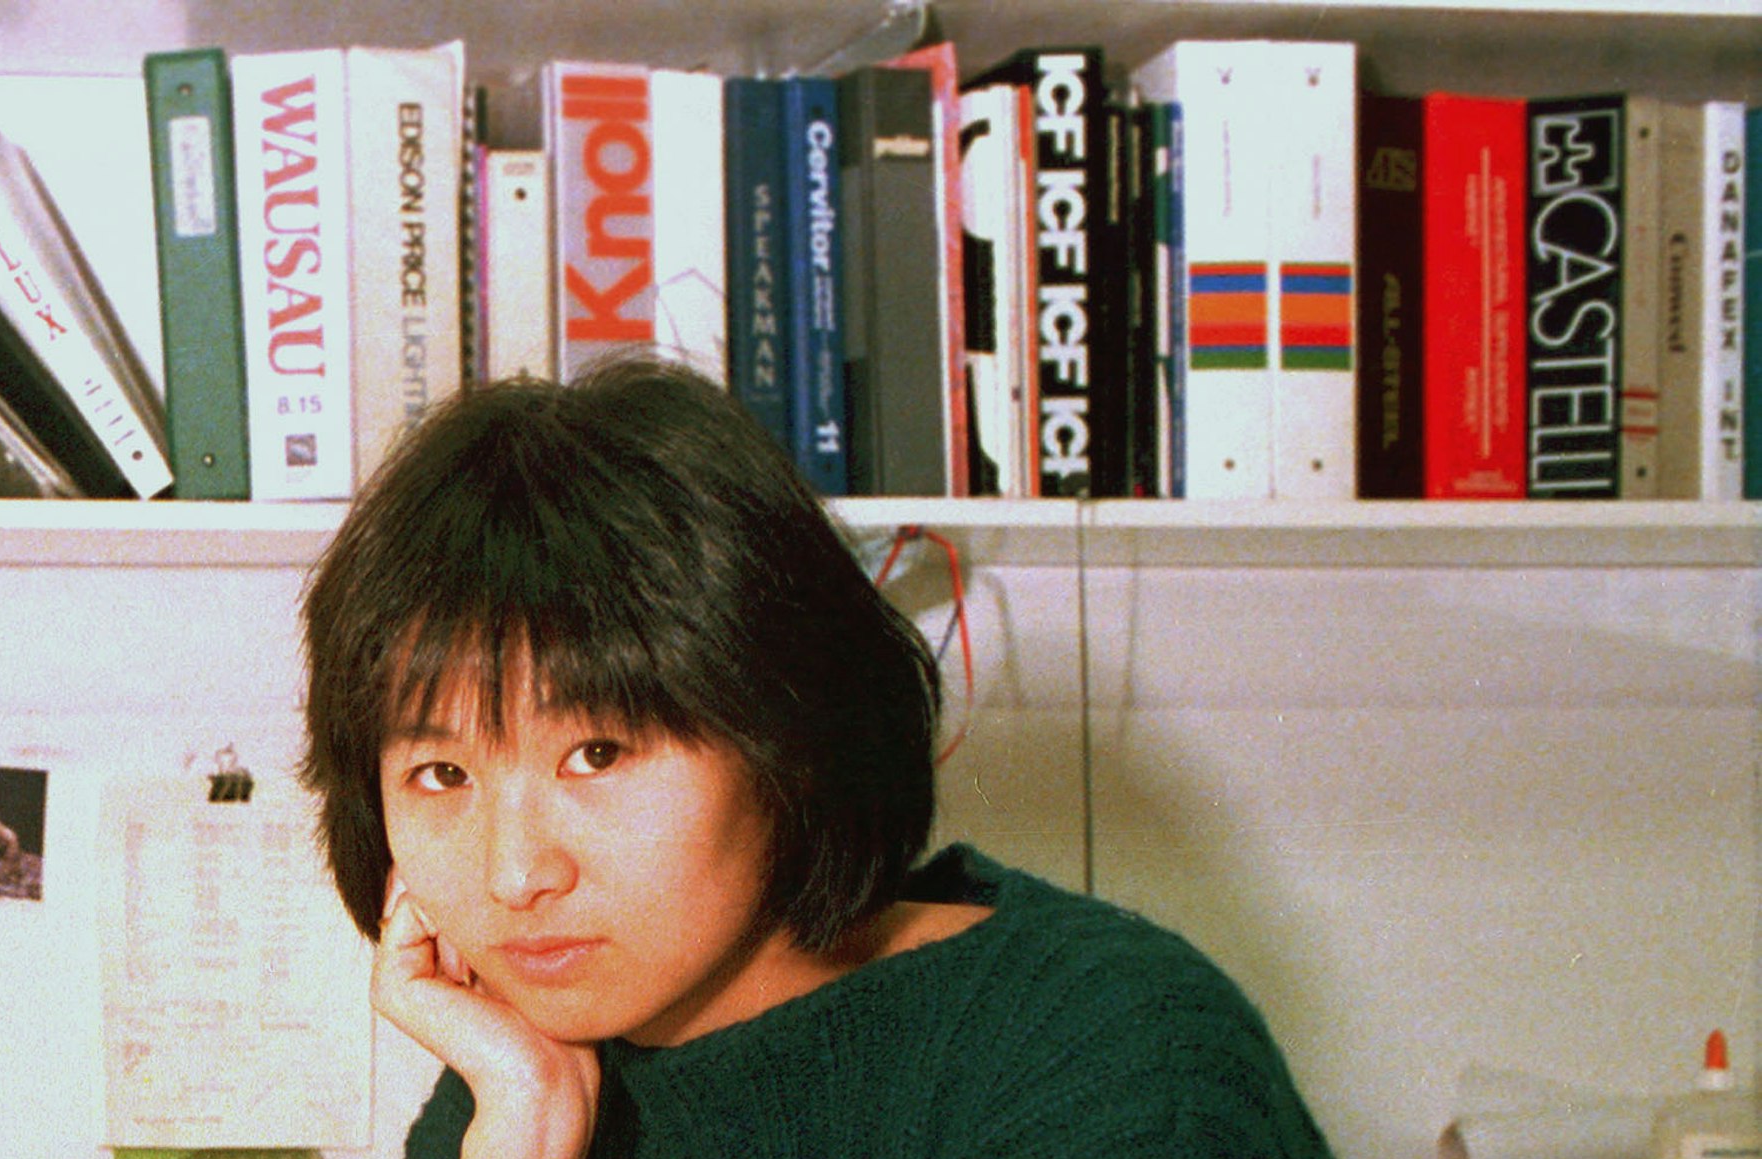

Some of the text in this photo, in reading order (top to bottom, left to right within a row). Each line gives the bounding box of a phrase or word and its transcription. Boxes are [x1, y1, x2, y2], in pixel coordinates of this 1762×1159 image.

[260, 75, 326, 378] WAUSAU
[397, 102, 425, 213] EDISON
[400, 221, 427, 308] PRICE
[561, 76, 654, 341] Knoll
[1533, 191, 1618, 491] CASTELLI
